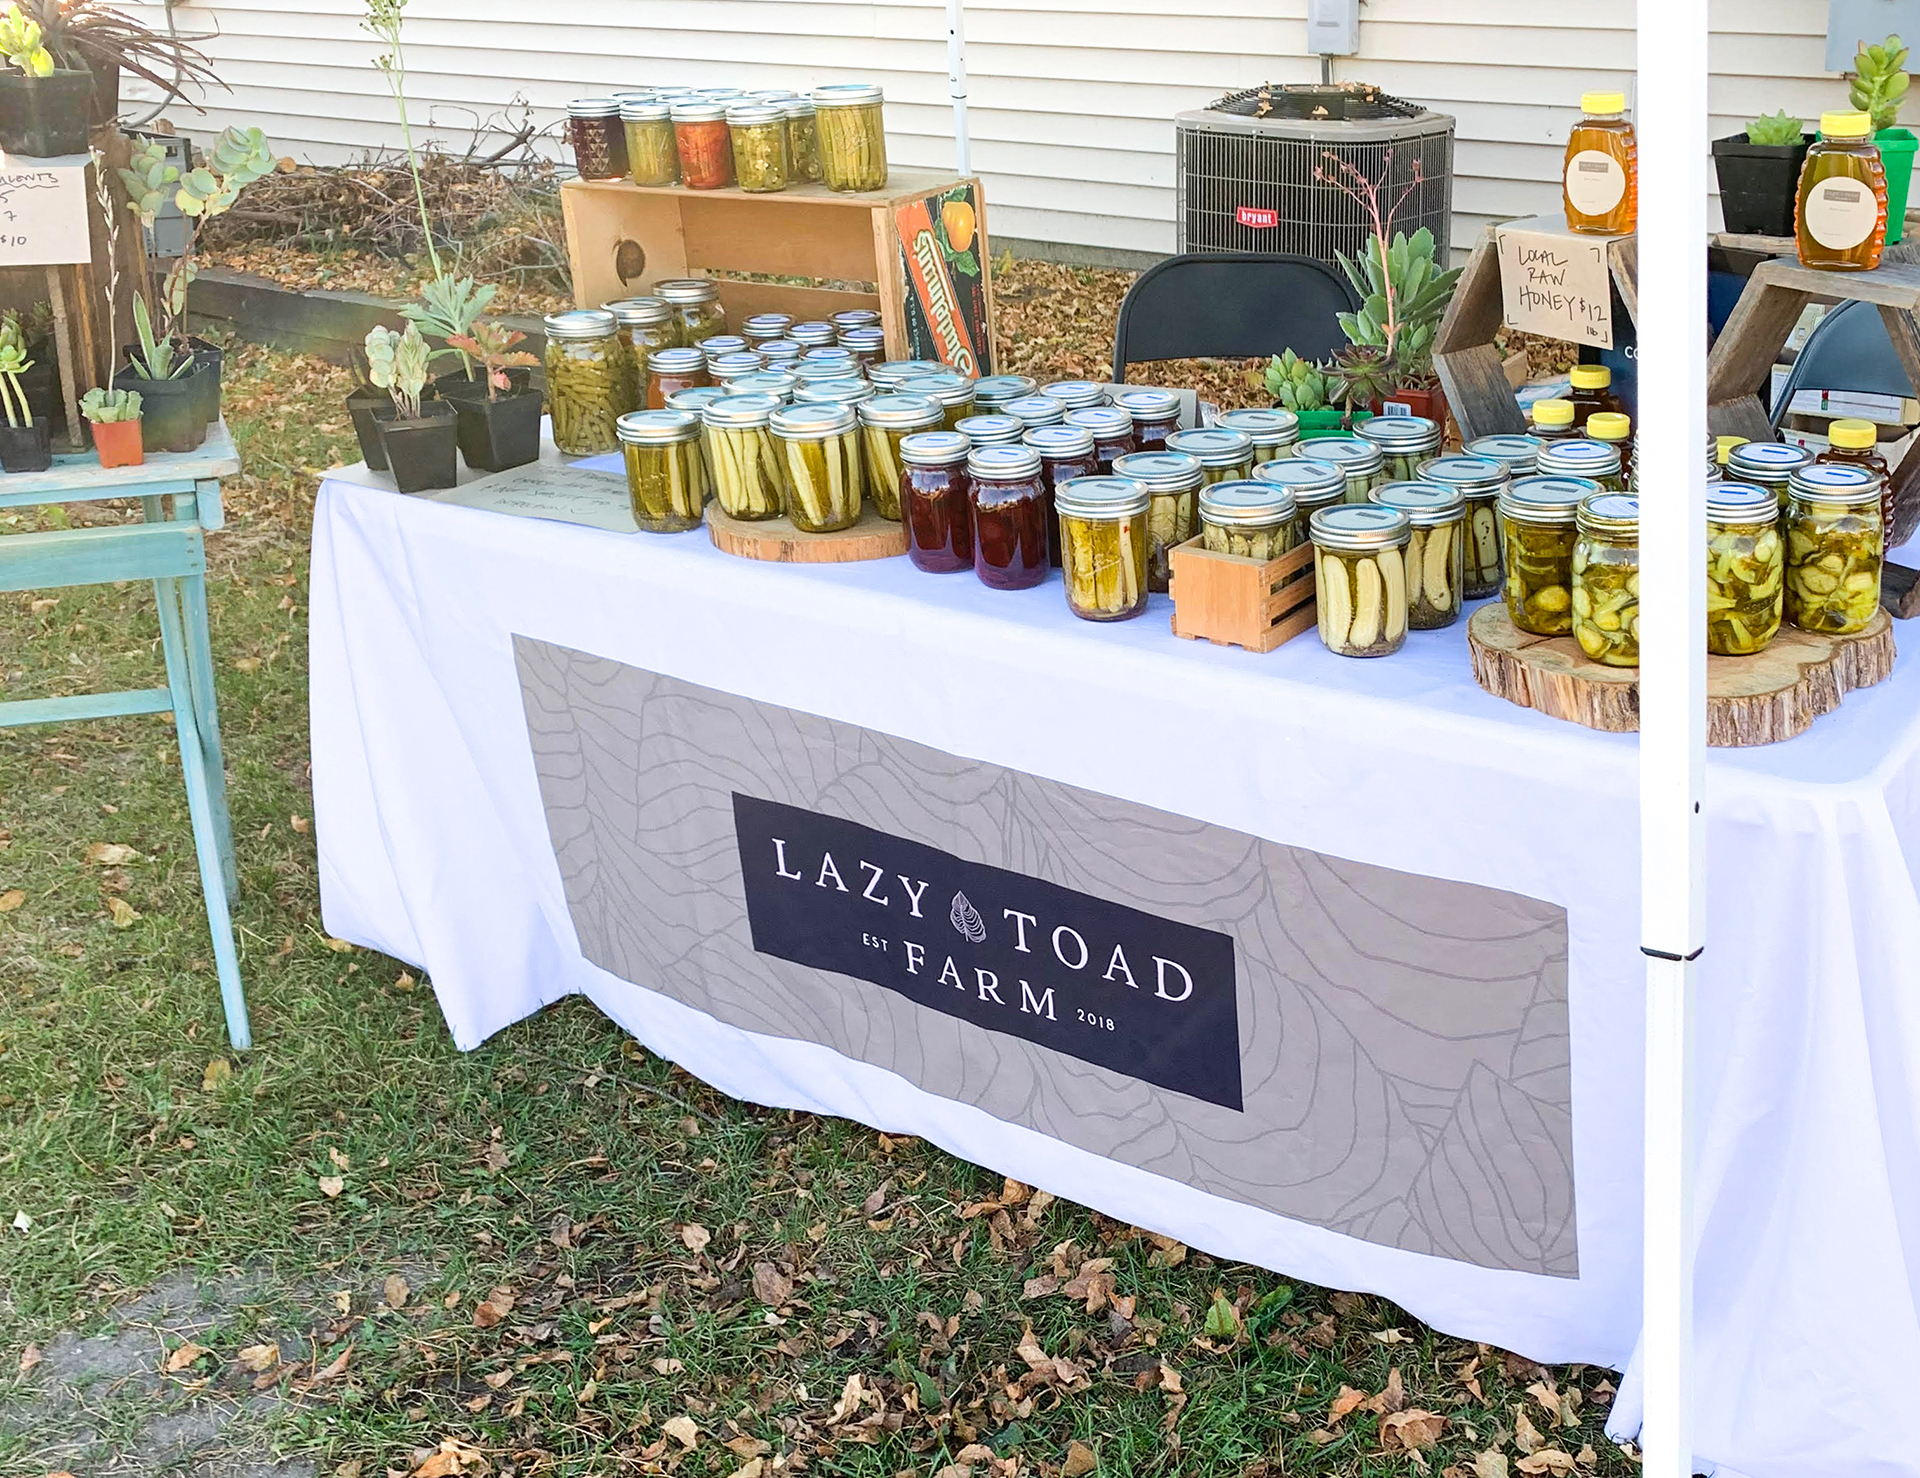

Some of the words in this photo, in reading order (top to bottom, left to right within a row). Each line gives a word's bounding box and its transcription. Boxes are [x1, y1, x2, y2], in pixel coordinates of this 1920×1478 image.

[1241, 210, 1272, 224] bryant
[1518, 245, 1568, 266] LOCAL
[1527, 267, 1566, 286] RAW
[1519, 285, 1576, 321] HONEY
[1579, 297, 1607, 322] $12
[771, 837, 930, 918] LAZY
[1002, 908, 1194, 1002] TOAD
[862, 932, 889, 952] EST
[902, 940, 1058, 1021] FARM
[1076, 1008, 1115, 1032] 2018
